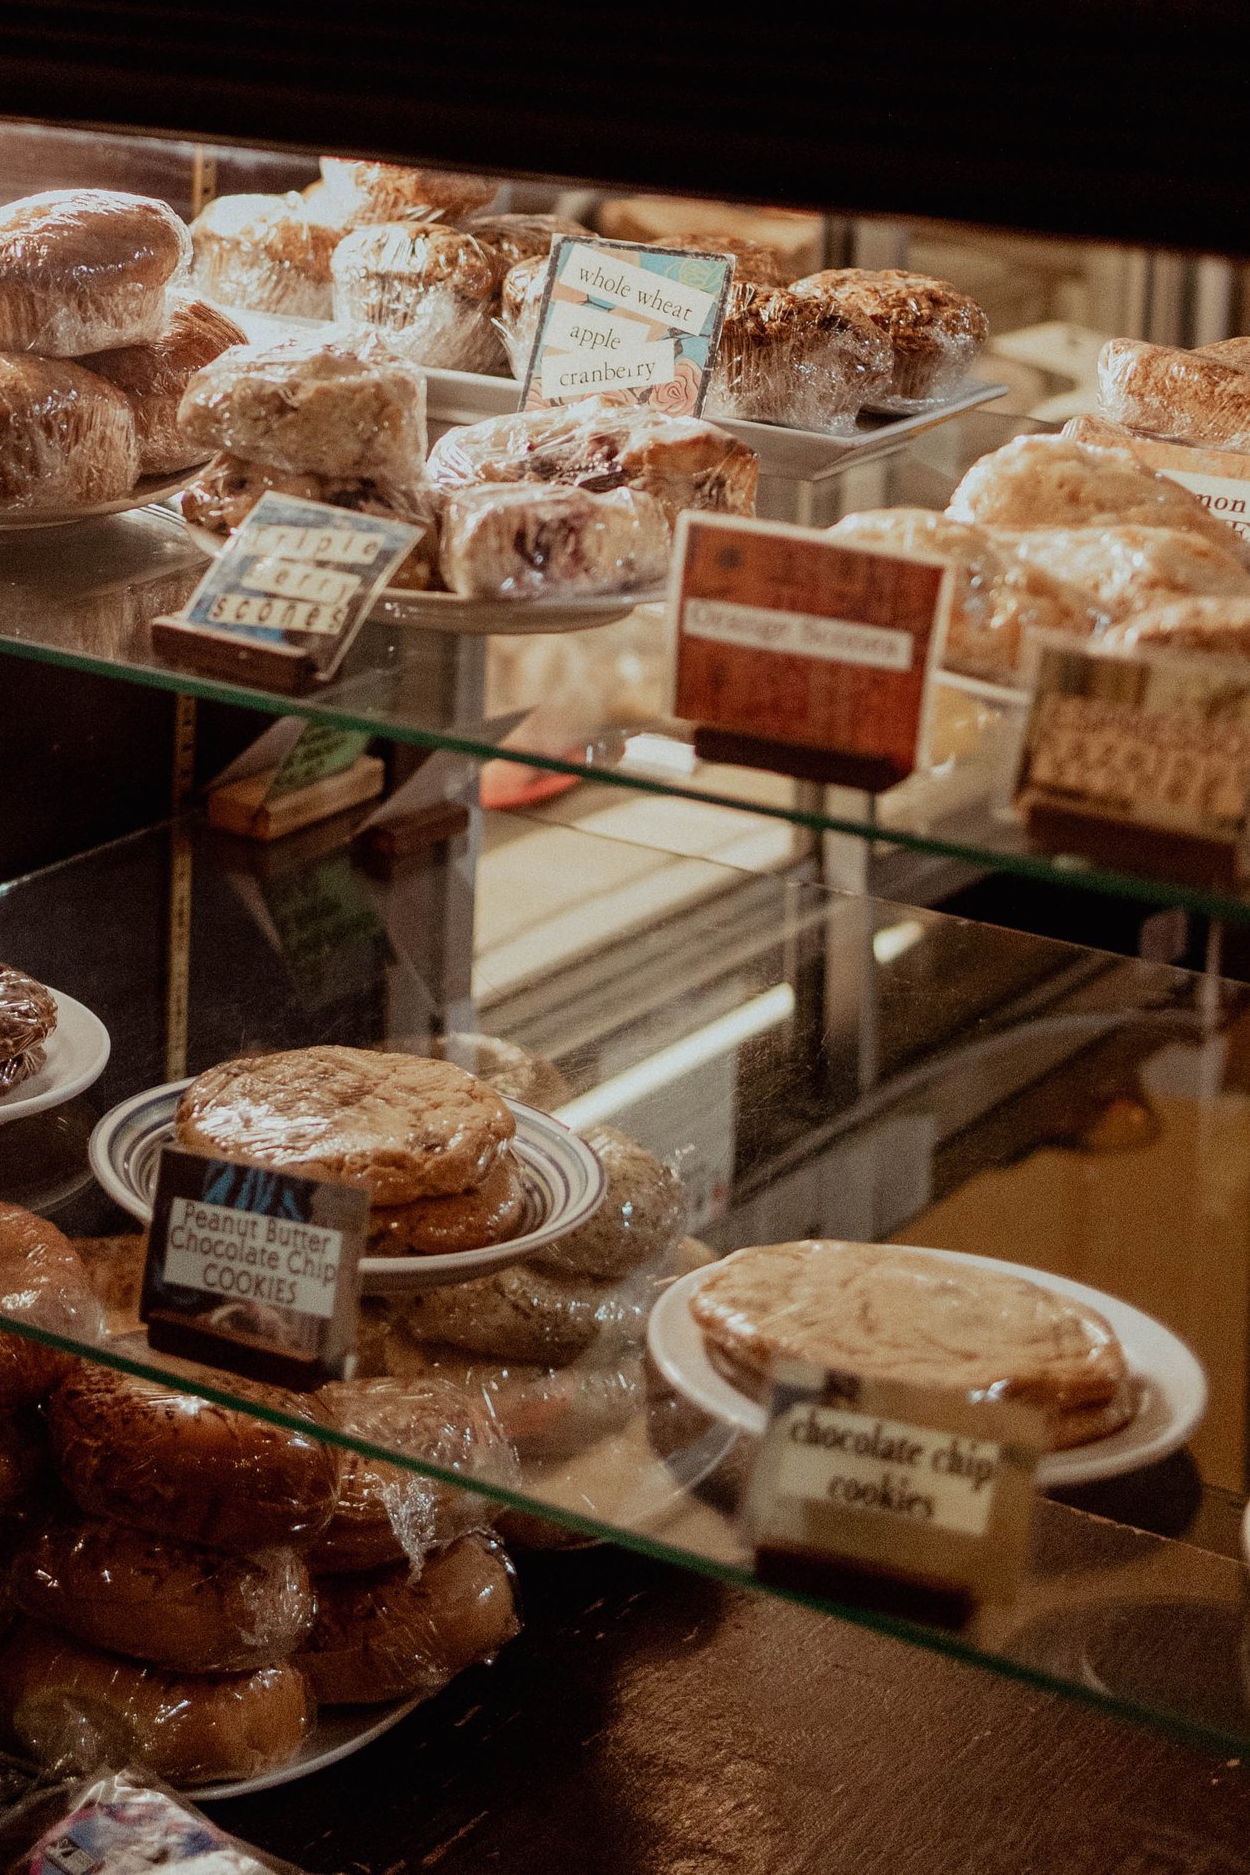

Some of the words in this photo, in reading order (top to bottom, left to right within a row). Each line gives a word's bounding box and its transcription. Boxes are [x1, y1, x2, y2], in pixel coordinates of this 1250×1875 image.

[578, 266, 631, 298] whole
[637, 288, 693, 322] wheat
[569, 325, 621, 350] apple
[249, 563, 348, 604] erry
[211, 596, 344, 629] scones
[183, 1200, 259, 1240] Peanut
[266, 1217, 331, 1255] Butter
[170, 1225, 280, 1270] Chocolate
[286, 1249, 338, 1287] Chip
[202, 1262, 298, 1304] COOKIES
